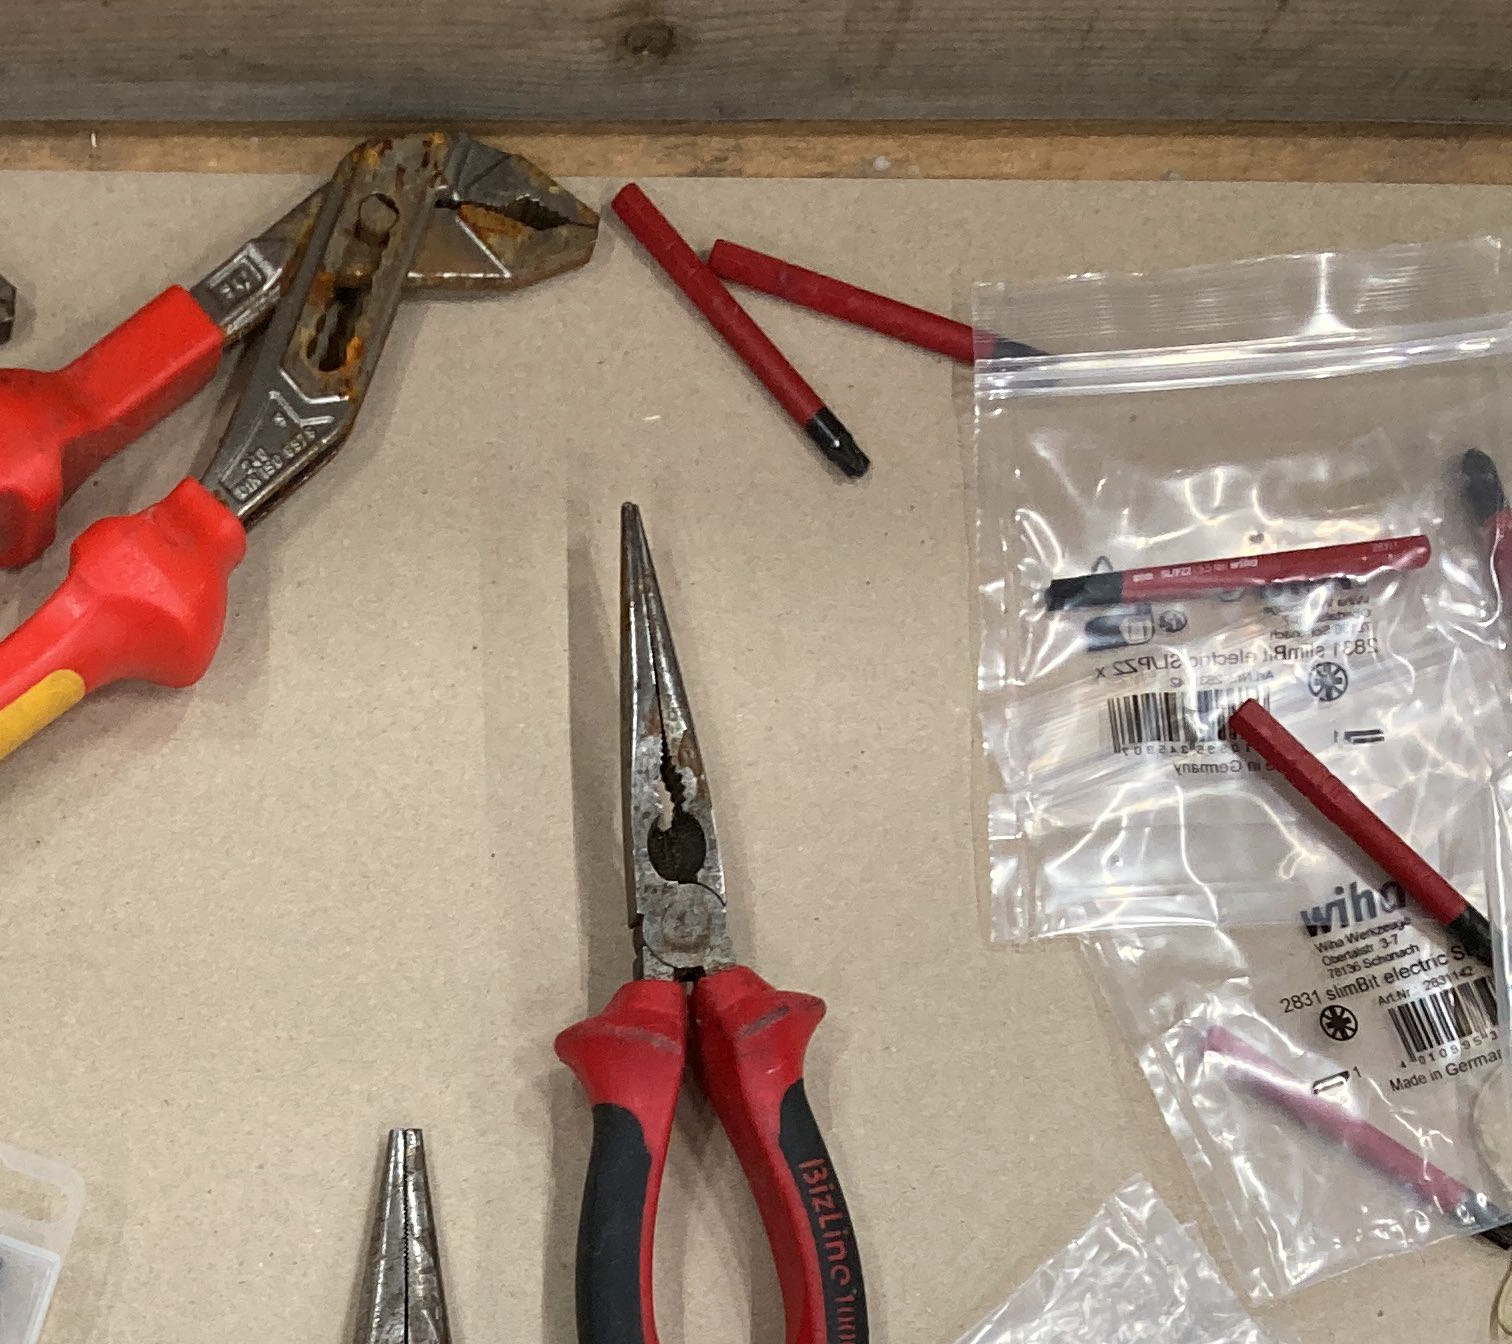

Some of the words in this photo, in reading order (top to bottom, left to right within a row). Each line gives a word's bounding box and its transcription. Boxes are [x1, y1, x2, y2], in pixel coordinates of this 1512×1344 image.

[1300, 881, 1409, 937] wiha
[1279, 989, 1324, 1014] 2831
[1326, 974, 1381, 1002] slimBit
[1383, 952, 1450, 985] electric
[1389, 1070, 1429, 1092] Made
[1430, 1066, 1443, 1081] in
